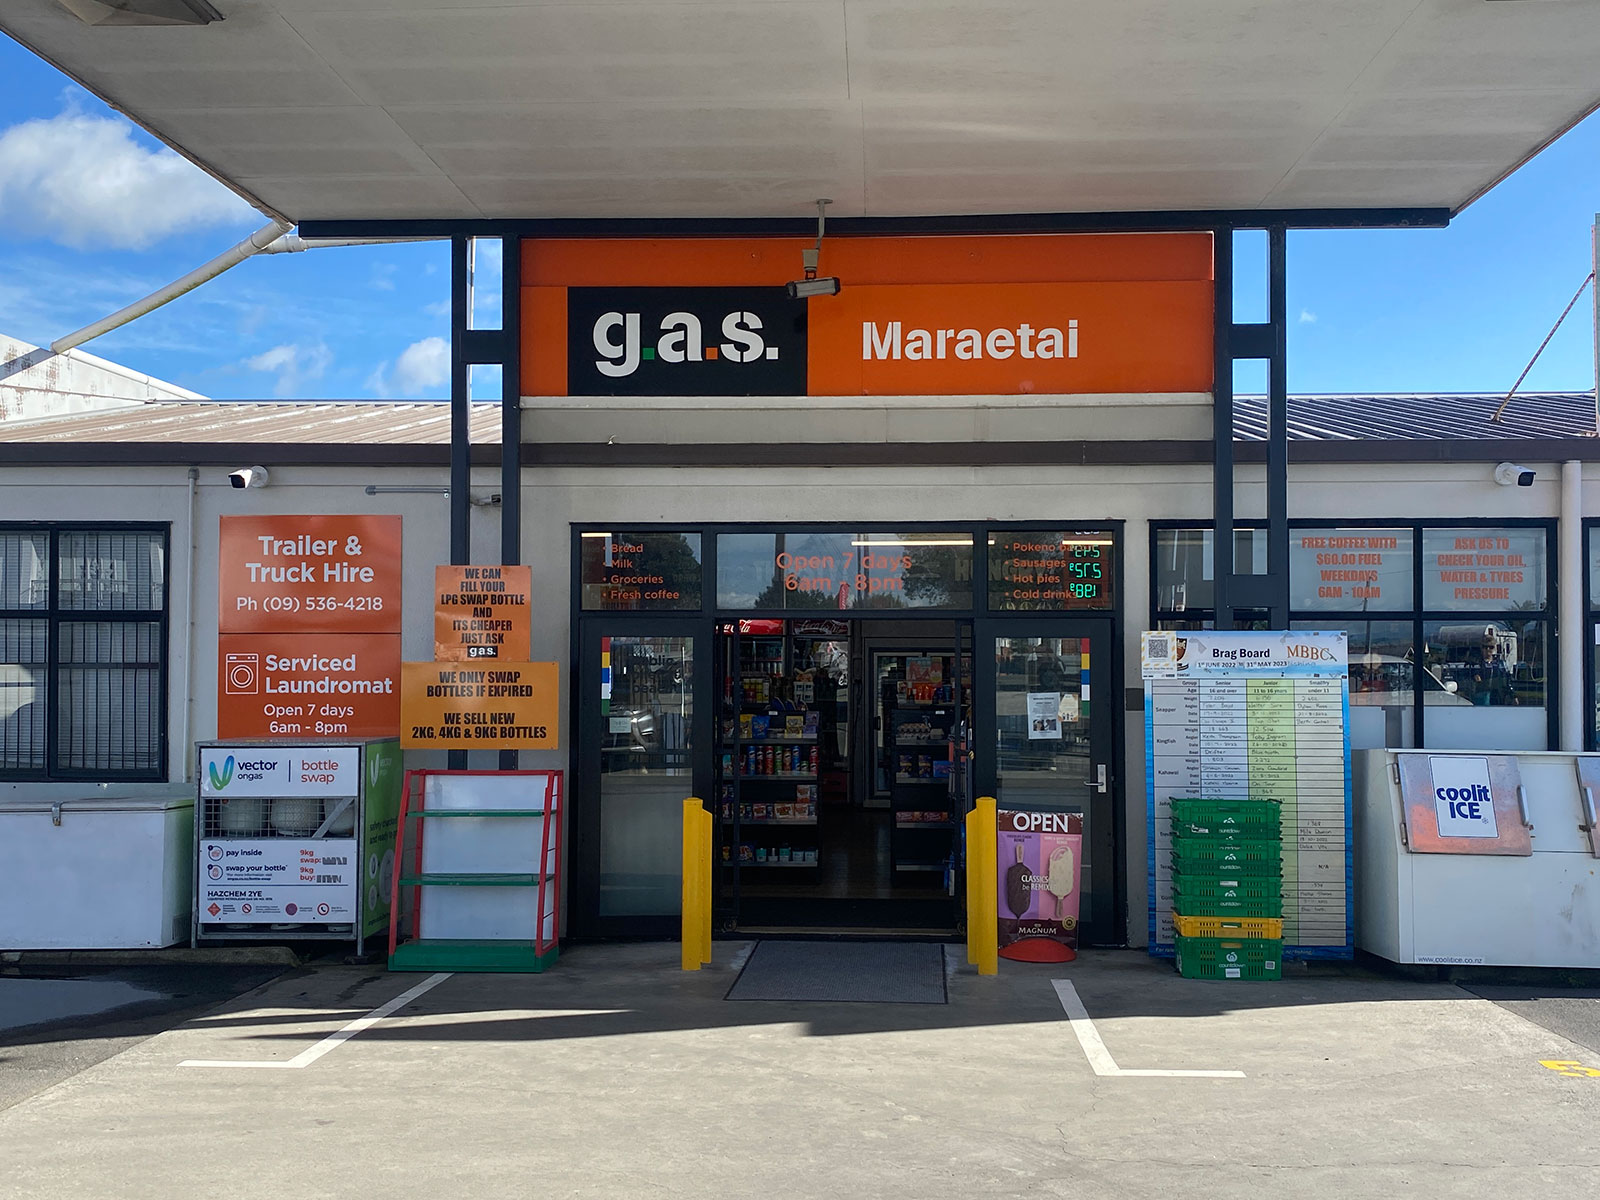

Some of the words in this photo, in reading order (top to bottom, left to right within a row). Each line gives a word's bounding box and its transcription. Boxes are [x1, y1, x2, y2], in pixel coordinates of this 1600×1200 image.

[862, 319, 1079, 361] Maraetai
[258, 535, 337, 556] Trailer
[345, 535, 362, 556] &
[1013, 542, 1056, 552] Pokeno
[1302, 537, 1328, 548] FREE
[1328, 537, 1366, 548] COFFEE
[1367, 537, 1397, 548] WITH
[1454, 538, 1476, 550] ASK
[1478, 538, 1494, 550] US
[1496, 538, 1509, 550] TO
[611, 544, 644, 553] Bread
[611, 559, 633, 569] Milk
[776, 552, 834, 571] Open
[842, 552, 853, 568] 7
[862, 552, 913, 572] days
[1013, 558, 1067, 569] Sausages
[1316, 553, 1356, 566] $60.00
[1358, 553, 1382, 565] FUEL
[1437, 555, 1473, 566] CHECK
[1475, 555, 1505, 566] YOUR
[1507, 555, 1527, 567] OIL,
[245, 562, 315, 583] Truck
[323, 562, 375, 583] Hire
[465, 568, 480, 579] WE
[482, 568, 501, 579] CAN
[1320, 570, 1378, 581] WEEKDAYS
[1440, 571, 1477, 582] WATER
[1479, 571, 1488, 582] &
[1490, 571, 1524, 582] TYRES
[611, 574, 664, 584] Groceries
[785, 573, 832, 591] 6am
[855, 573, 904, 594] 8pm
[1013, 574, 1034, 584] Hot
[1036, 574, 1061, 586] pies
[460, 581, 478, 592] FILL
[480, 581, 505, 592] YOUR
[1318, 586, 1343, 598] 6AM
[1351, 586, 1381, 598] 10AM
[611, 590, 641, 600] Fresh
[644, 590, 680, 600] coffee
[1013, 589, 1040, 599] Cold
[1043, 589, 1078, 599] drinks
[1454, 587, 1510, 599] PRESSURE
[237, 597, 258, 611] Ph
[263, 597, 300, 613] (09)
[305, 597, 383, 611] 536-4218
[441, 594, 458, 605] LPG
[460, 594, 488, 605] SWAP
[490, 594, 525, 605] BOTTLE
[472, 607, 492, 618] AND
[453, 620, 468, 631] ITS
[470, 620, 512, 631] CHEAPER
[460, 633, 483, 644] JUST
[485, 633, 504, 644] ASK
[1212, 648, 1237, 660] Brag
[1240, 648, 1270, 658] Board
[1287, 644, 1330, 661] MBBC
[265, 654, 356, 672] Serviced
[439, 672, 458, 683] WE
[459, 672, 486, 683] ONLY
[488, 672, 521, 683] SWAP
[265, 676, 393, 694] Laundromat
[427, 685, 474, 697] BOTTLES
[476, 685, 486, 697] IF
[488, 685, 533, 697] EXPIRED
[264, 704, 303, 718] Open
[308, 704, 316, 716] 7
[320, 704, 354, 718] days
[444, 713, 462, 724] WE
[464, 713, 488, 724] SELL
[490, 713, 515, 724] NEW
[269, 722, 301, 733] 6am
[314, 722, 348, 735] 8pm
[412, 727, 437, 739] 2KG,
[439, 727, 462, 738] 4KG
[464, 727, 472, 738] &
[474, 727, 497, 738] 9KG
[500, 727, 547, 739] BOTTLES
[238, 760, 278, 771] vector
[301, 760, 339, 771] bottle
[237, 772, 263, 782] ongas
[301, 774, 335, 785] swap
[1436, 784, 1490, 802] coolit
[1449, 802, 1482, 819] ICE
[1013, 812, 1069, 833] OPEN
[300, 874, 316, 882] buy:
[1021, 874, 1050, 882] CLASSICS
[1018, 926, 1057, 935] MAGNUM
